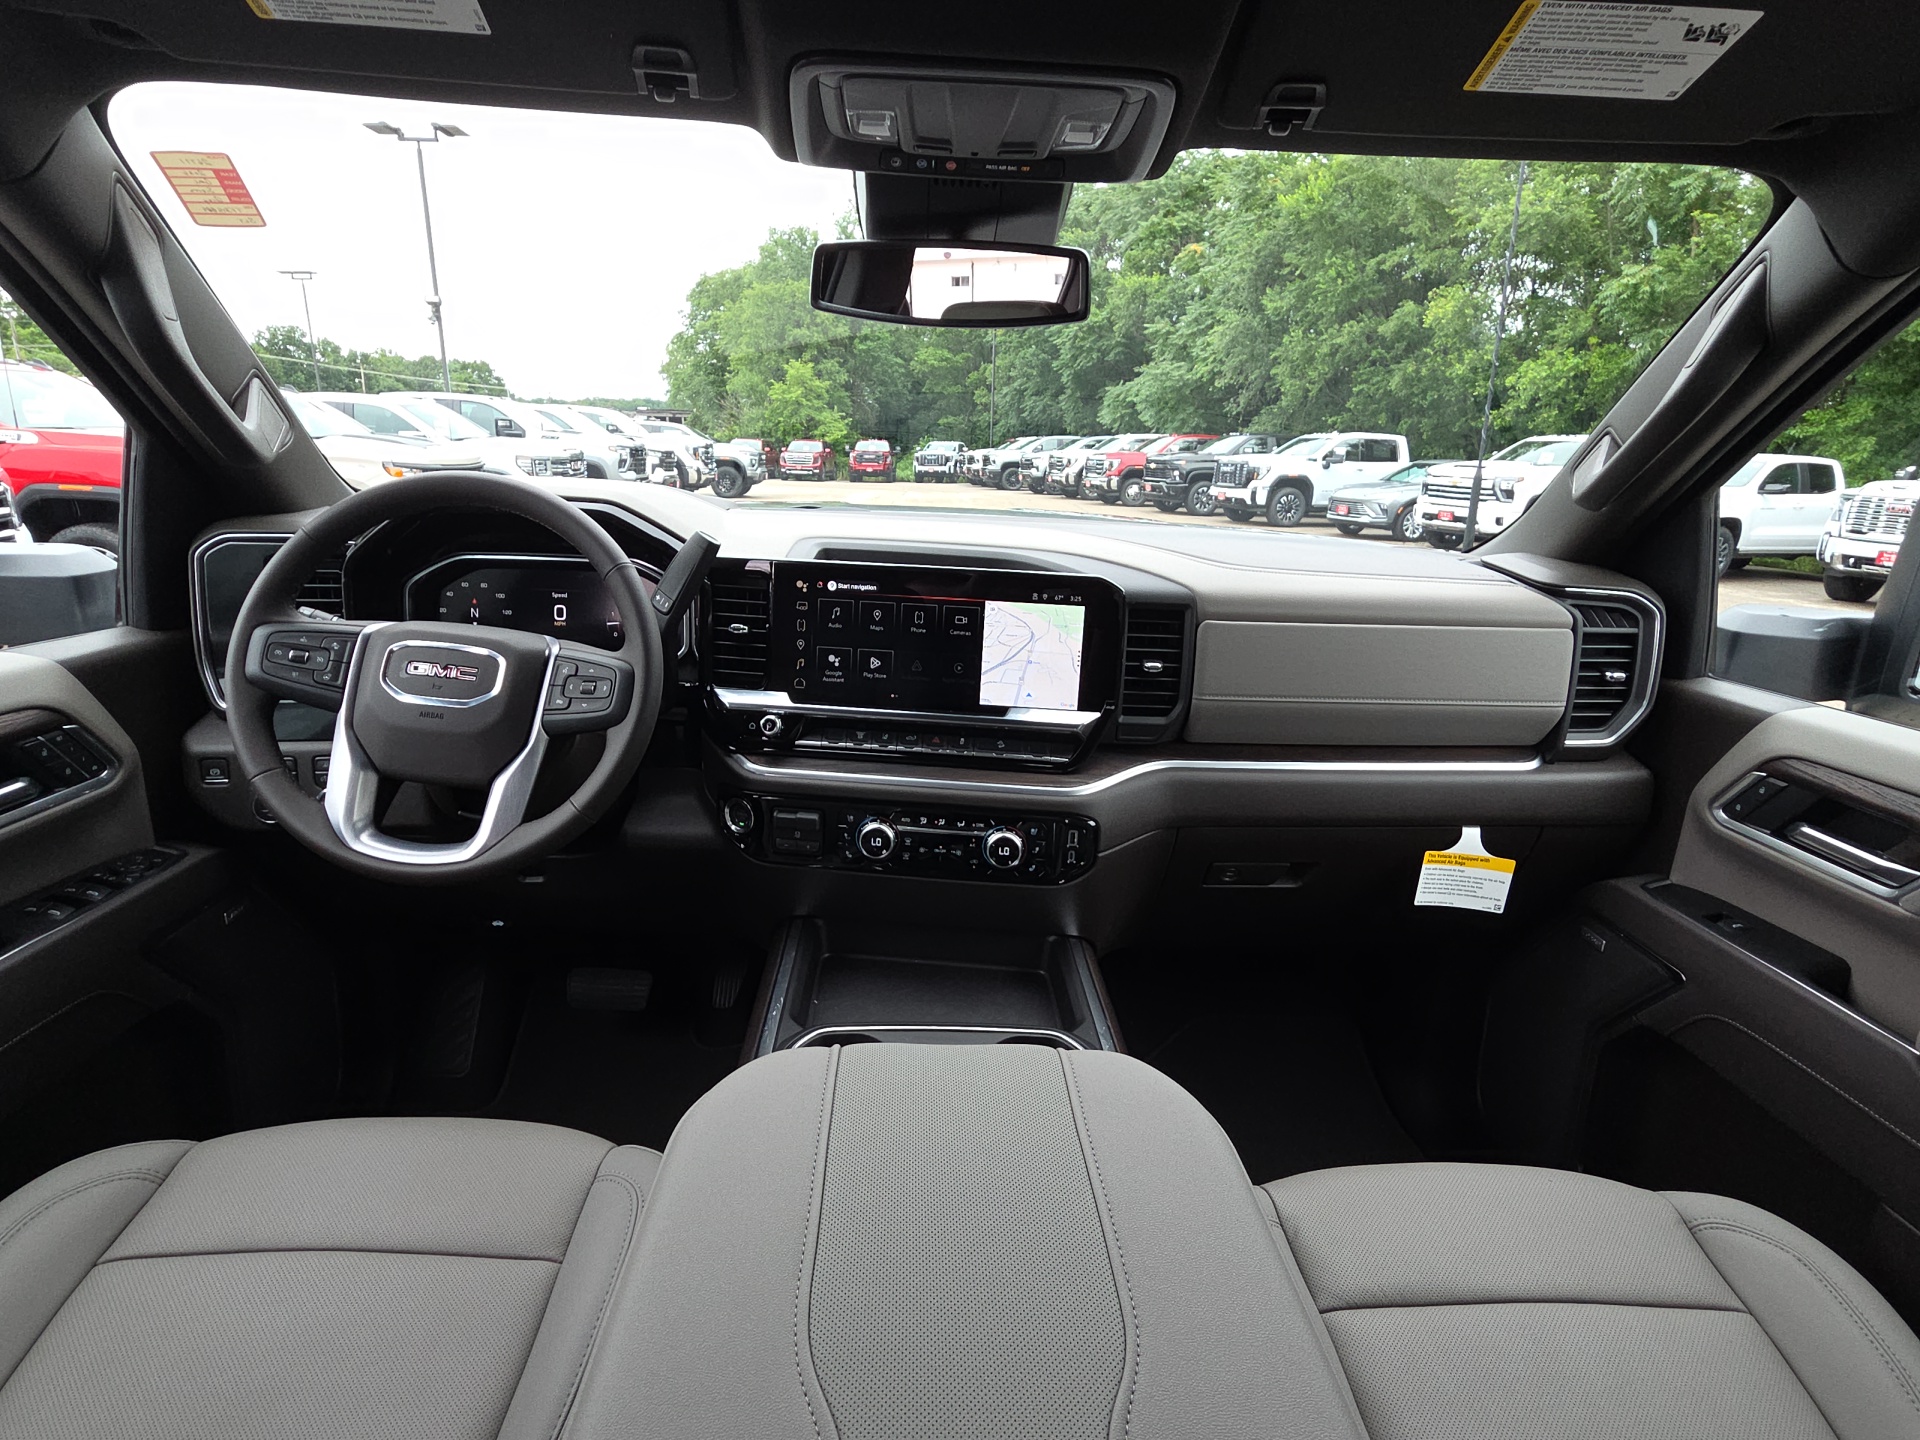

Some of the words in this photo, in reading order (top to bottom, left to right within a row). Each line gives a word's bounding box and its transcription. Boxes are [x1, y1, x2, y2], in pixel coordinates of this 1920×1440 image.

[838, 582, 850, 590] Start
[850, 583, 877, 591] navigation
[470, 608, 479, 618] N
[553, 604, 567, 621] 0
[870, 624, 884, 632] Maps
[405, 661, 478, 681] GMC
[825, 669, 843, 677] Google
[419, 711, 444, 720] AIRBAG
[1459, 854, 1479, 862] Equipped
